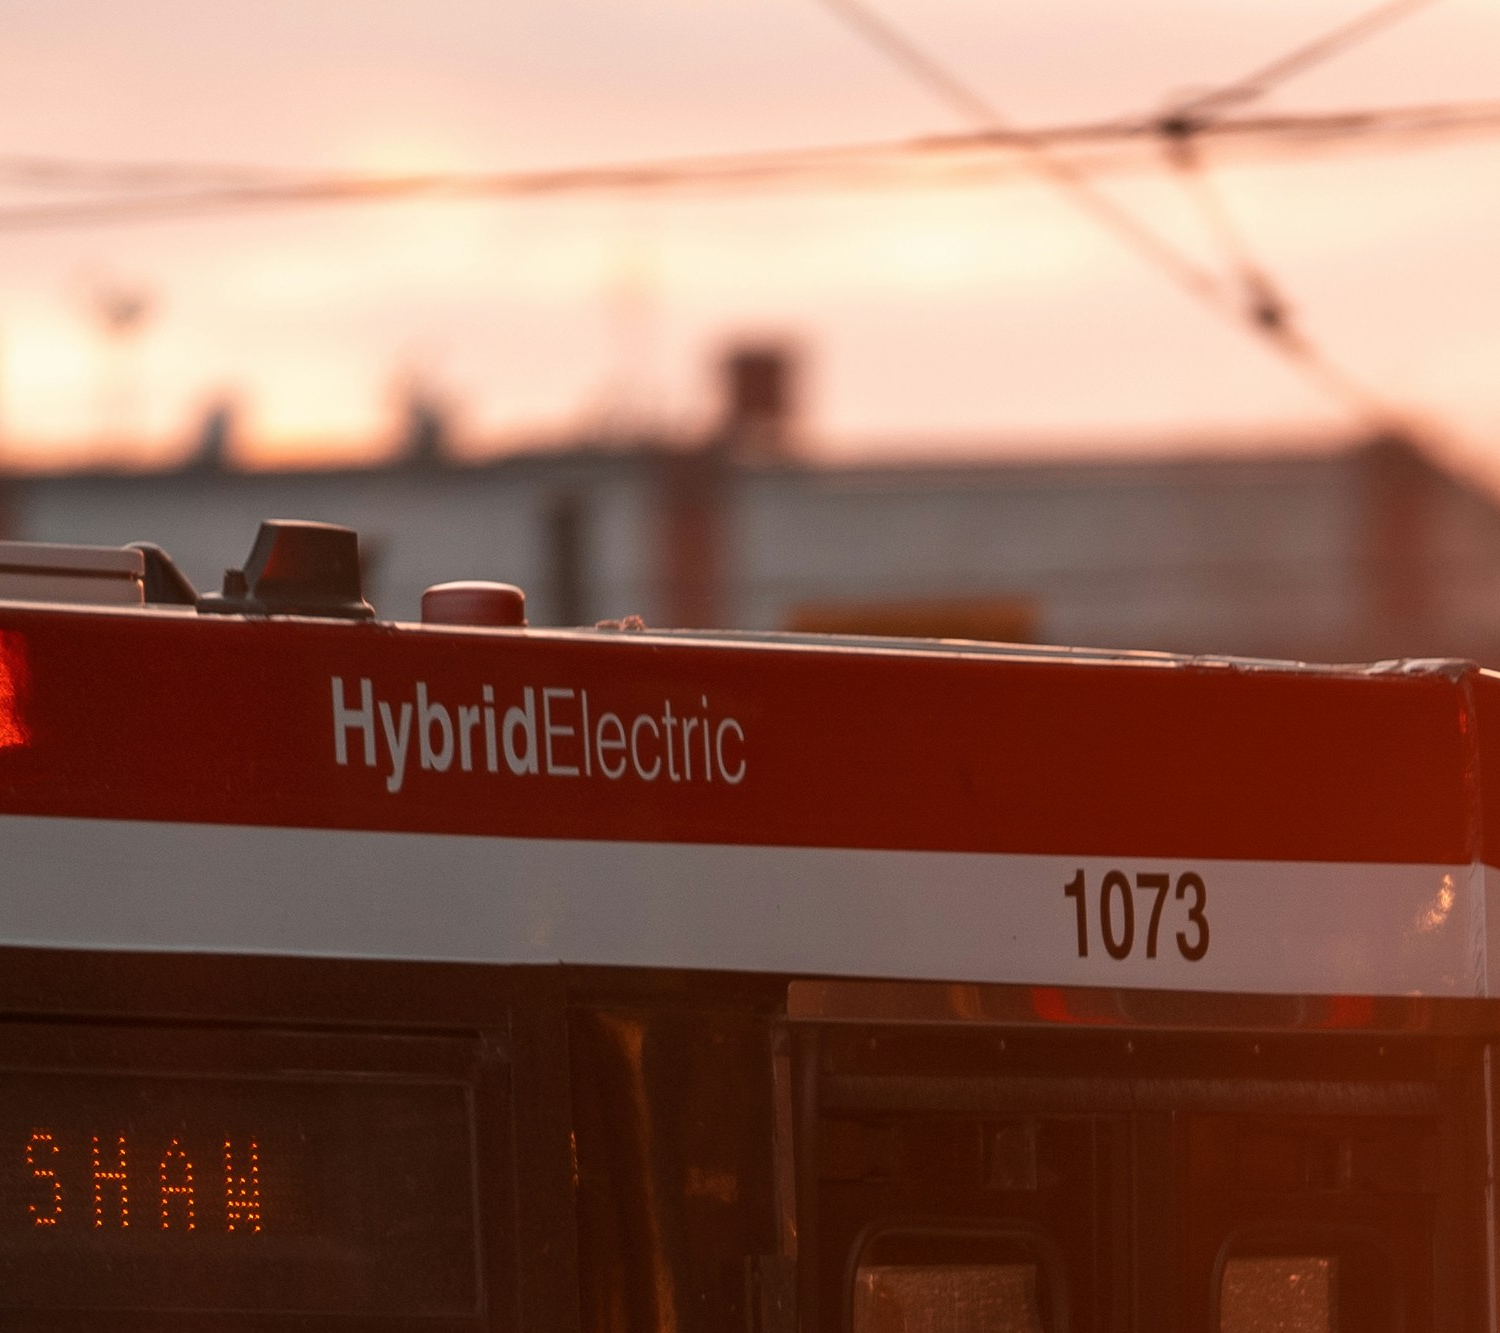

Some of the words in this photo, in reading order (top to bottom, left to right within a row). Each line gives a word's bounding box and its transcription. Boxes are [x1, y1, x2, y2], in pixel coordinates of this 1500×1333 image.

[330, 675, 747, 795] HybridElectric
[1063, 867, 1211, 963] 1073
[25, 1130, 264, 1234] SHAW
